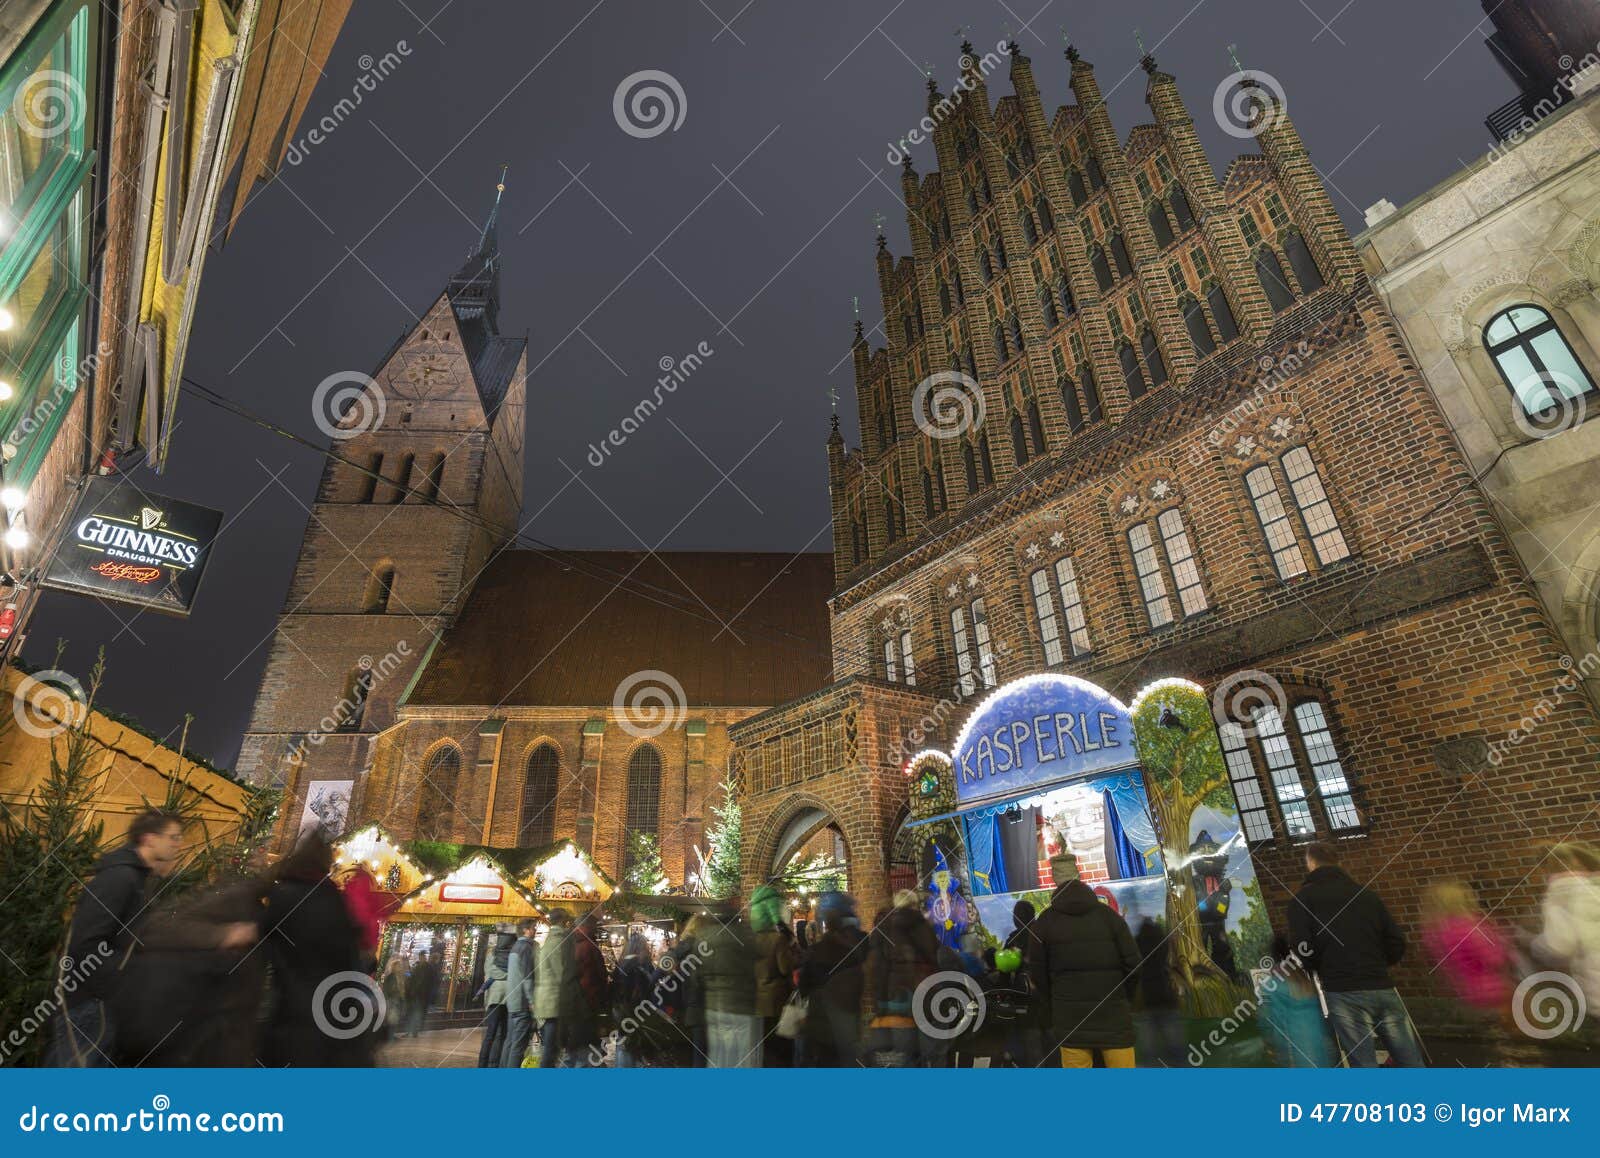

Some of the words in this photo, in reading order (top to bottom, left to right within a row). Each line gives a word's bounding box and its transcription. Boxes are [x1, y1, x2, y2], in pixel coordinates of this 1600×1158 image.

[77, 517, 198, 564] GUINNESS
[107, 548, 162, 565] DRAUGHT
[960, 711, 1121, 785] KASPERLE
